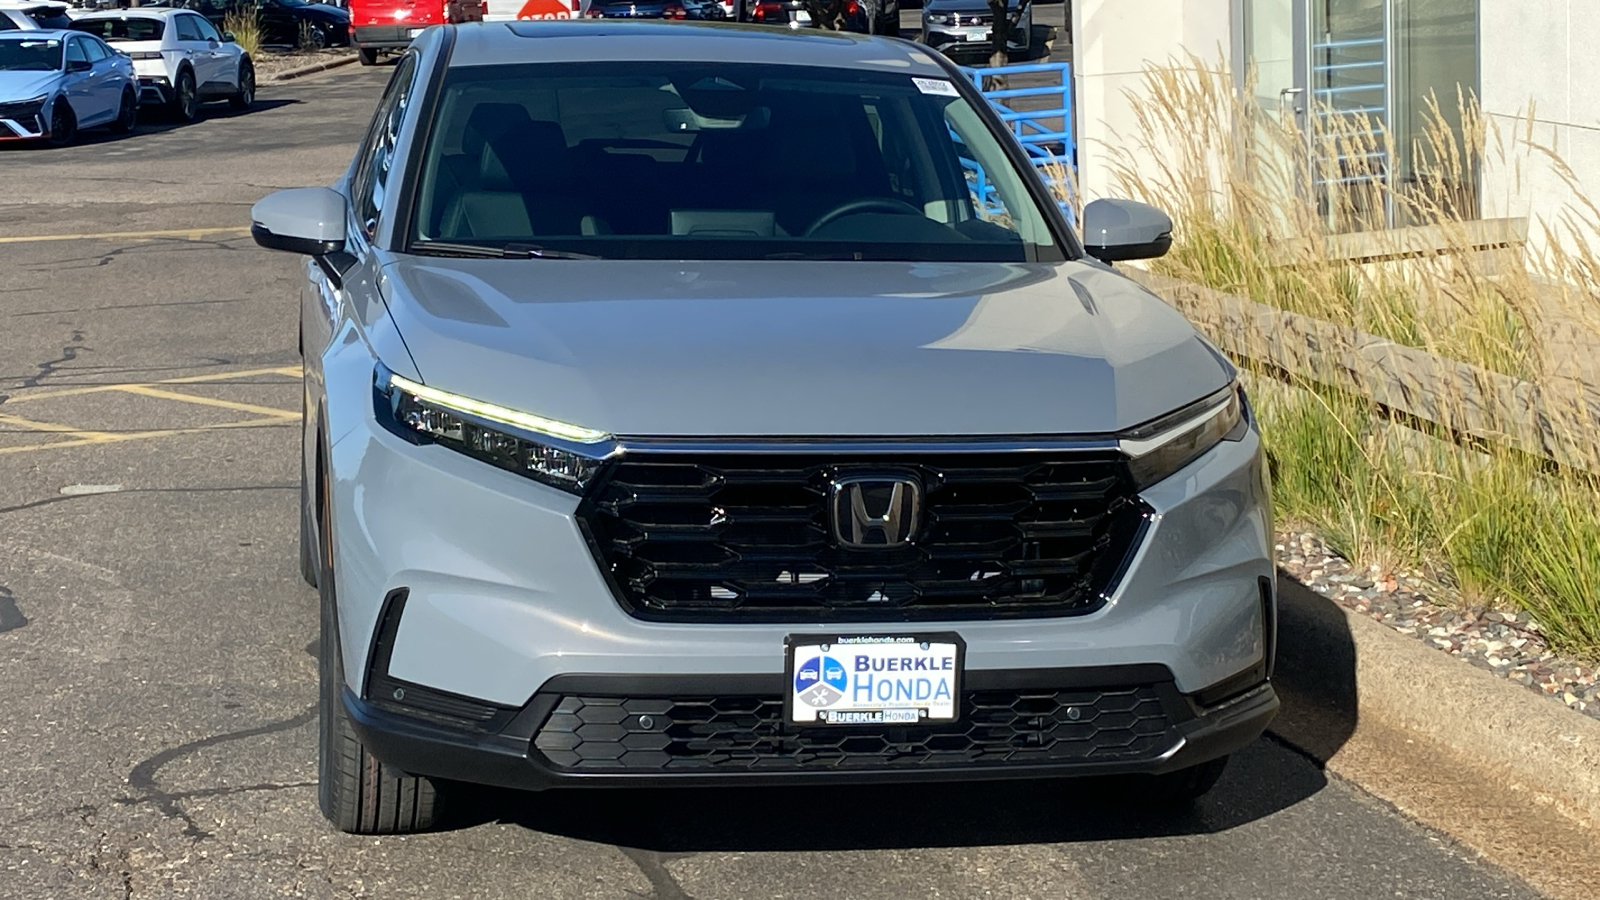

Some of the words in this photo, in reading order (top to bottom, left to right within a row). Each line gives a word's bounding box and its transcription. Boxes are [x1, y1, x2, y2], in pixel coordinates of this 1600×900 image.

[837, 636, 915, 644] buerklehonda.com
[854, 655, 953, 672] BUERKLE
[853, 674, 952, 702] HONDA
[828, 711, 884, 723] BUERKLE
[884, 711, 917, 721] HONDA
